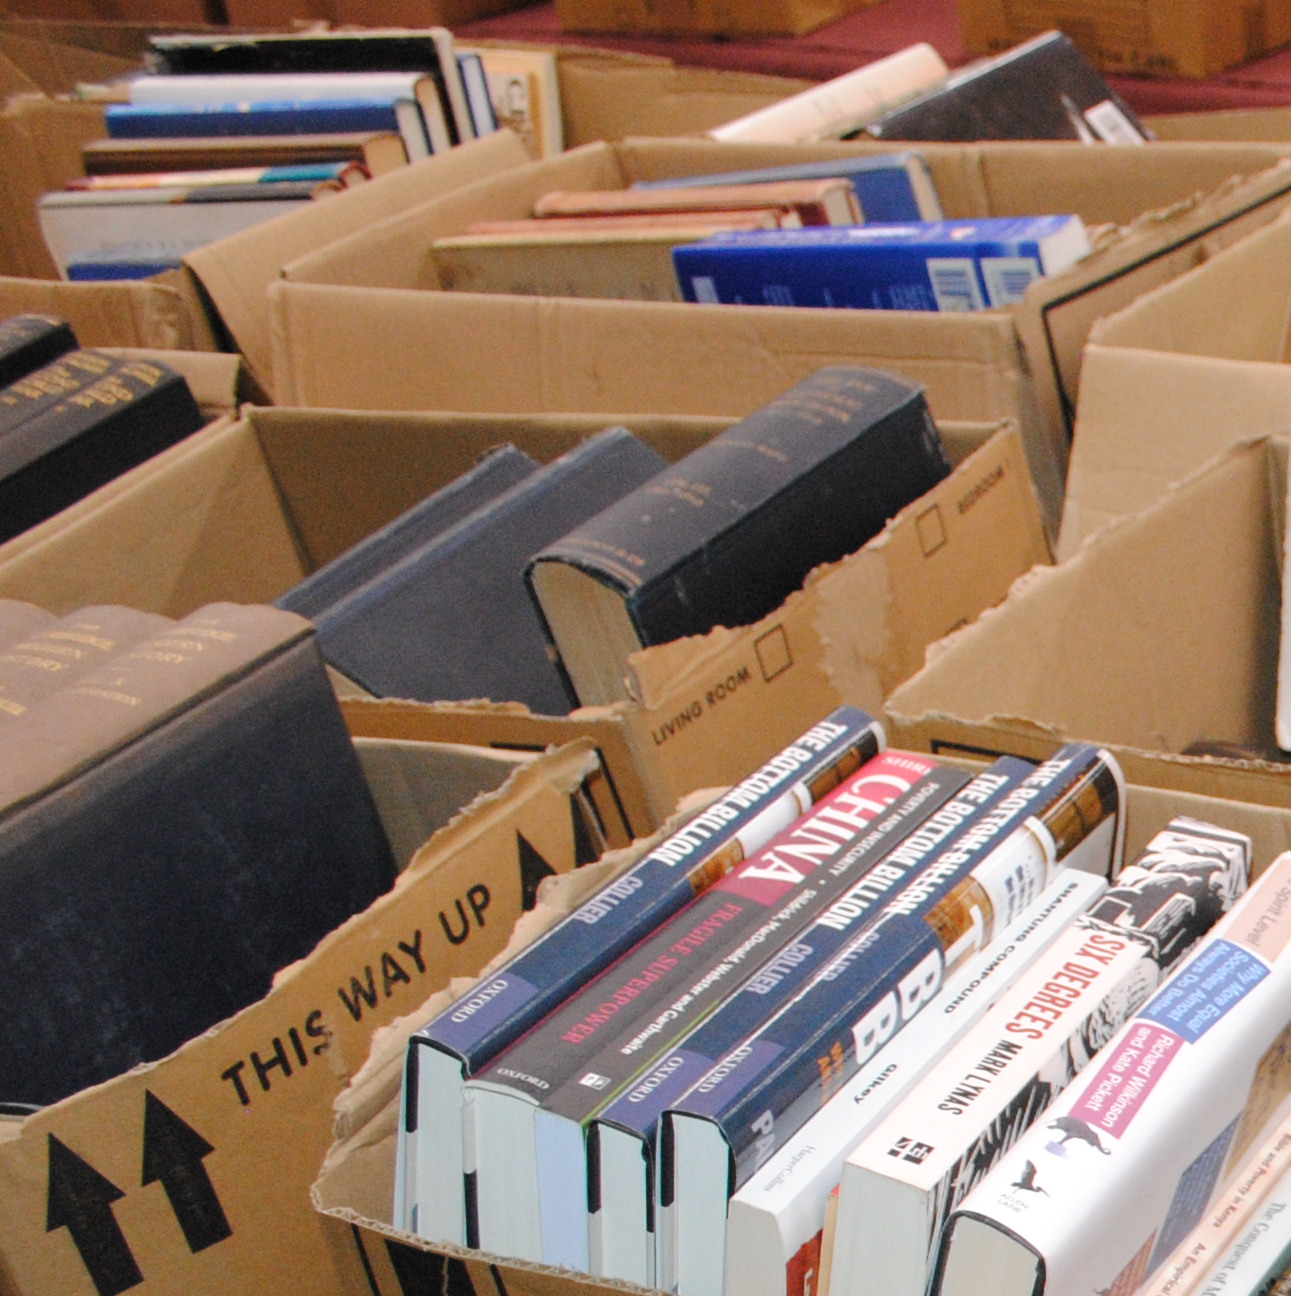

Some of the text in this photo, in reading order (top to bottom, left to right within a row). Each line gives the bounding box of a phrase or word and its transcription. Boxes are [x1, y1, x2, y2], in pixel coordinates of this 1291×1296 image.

[652, 666, 751, 746] LIVING ROOM
[643, 718, 850, 867] THE BOTTOM BILLION
[1018, 757, 1076, 788] THE
[738, 772, 913, 886] CHINA
[811, 772, 1011, 933] THE BOTTOM BILLION
[825, 780, 941, 877] POVERTY INSECURITY
[574, 876, 645, 925] COLLIER
[1015, 882, 1079, 943] SHANTUNG
[1245, 911, 1276, 948] Level
[561, 903, 744, 1046] FRAGILE SUPERPOWER
[618, 918, 781, 1058] MacDonald, Webster and Garthwaite
[747, 944, 815, 996] COLLIER
[822, 932, 881, 981] COLLIER
[944, 944, 1015, 1015] COMPOUND
[1004, 933, 1126, 1041] SIX DEGREES
[1146, 941, 1231, 1017] Always Do Better
[1166, 949, 1249, 1024] Societies Almost
[220, 880, 496, 1110] THIS WAY UP
[450, 978, 509, 1024] OXFORD
[1186, 962, 1266, 1035] Why More Equal
[497, 1067, 551, 1091] OXFORD
[628, 1055, 684, 1103] OXFORD
[698, 1046, 753, 1094] OXFORD
[853, 1062, 898, 1105] Gilkey
[937, 1039, 1024, 1116] MARK LYNAS
[1083, 1026, 1152, 1113] and Kate Pickett
[1101, 1033, 1176, 1130] Richard Wilkinson
[1212, 1165, 1268, 1229] Poverty Kenya
[1263, 1200, 1288, 1225] The
[1166, 1255, 1197, 1296] Empirical
[1193, 1242, 1207, 1259] An
[1218, 1265, 1236, 1287] of
[1232, 1221, 1270, 1273] Conquest
